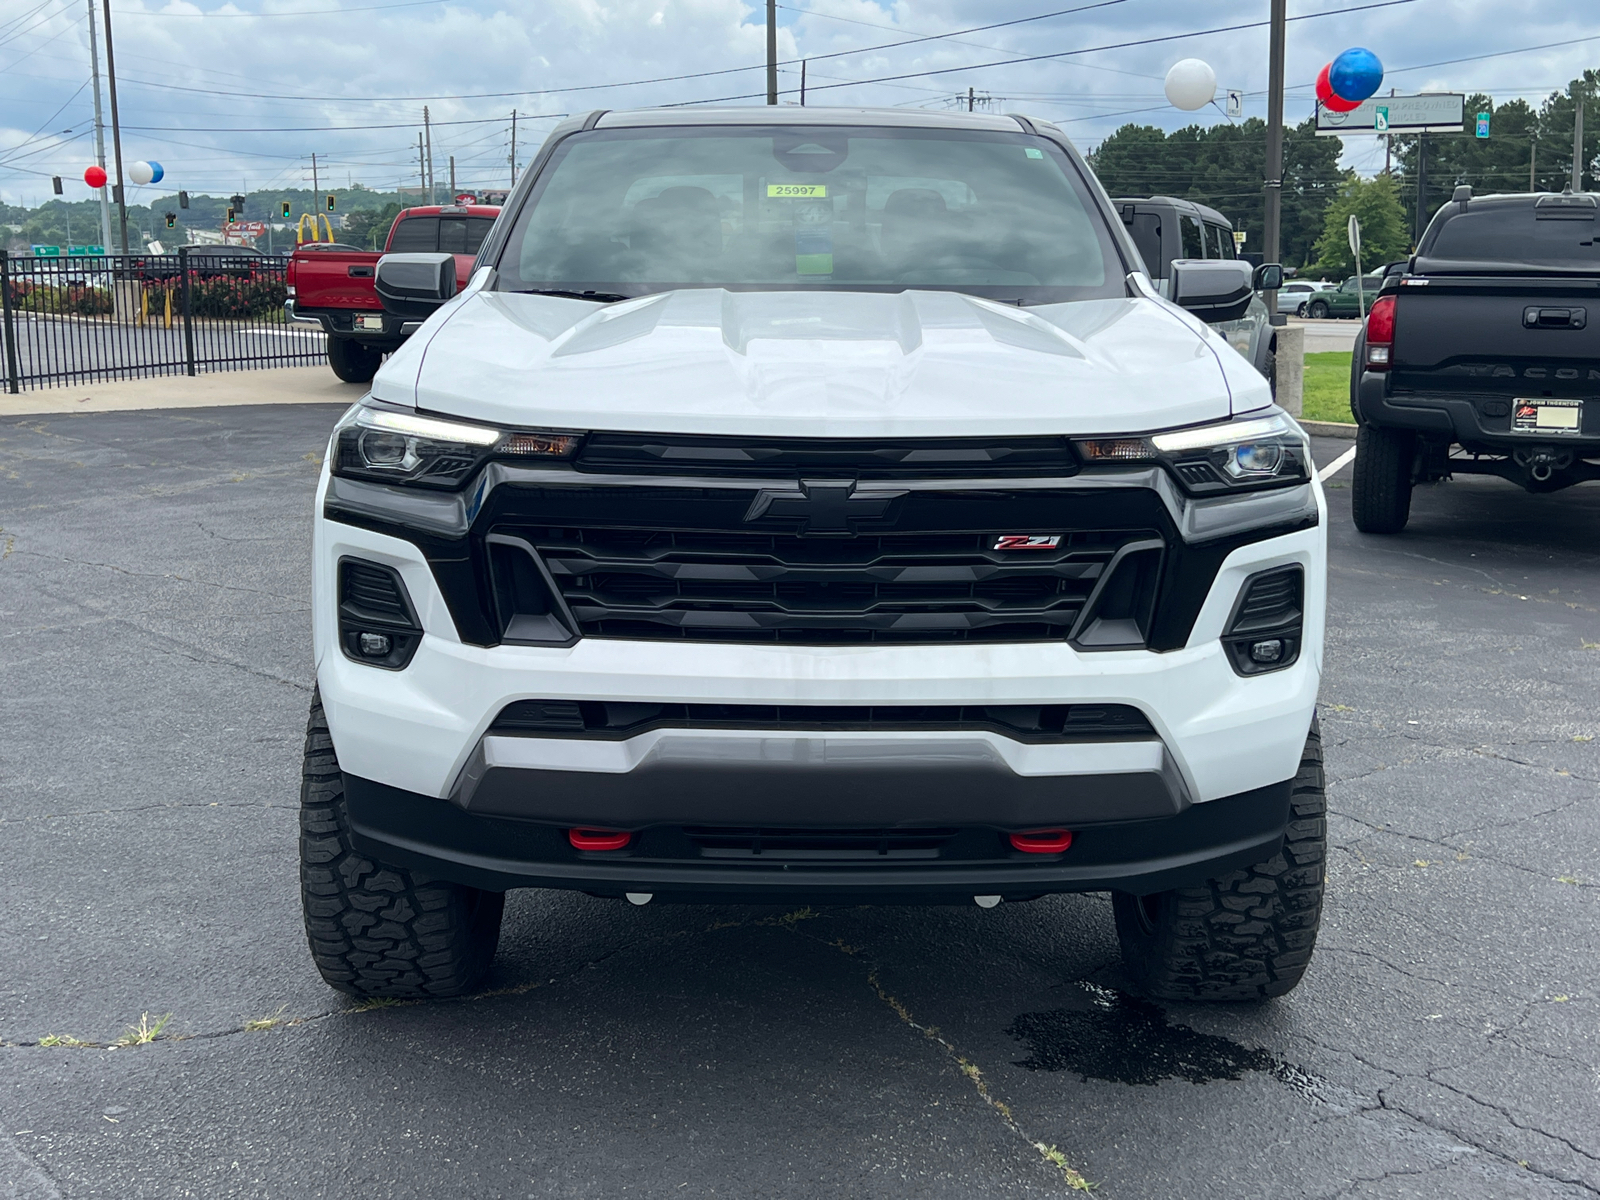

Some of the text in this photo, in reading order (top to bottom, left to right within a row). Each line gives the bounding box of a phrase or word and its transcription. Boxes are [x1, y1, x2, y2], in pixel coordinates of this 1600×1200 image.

[1402, 101, 1458, 110] PRE-OWNED
[1379, 117, 1384, 127] 6
[1389, 113, 1426, 122] EHICLES
[1479, 125, 1487, 133] 20
[775, 186, 816, 195] 25997
[993, 535, 1061, 550] Z71
